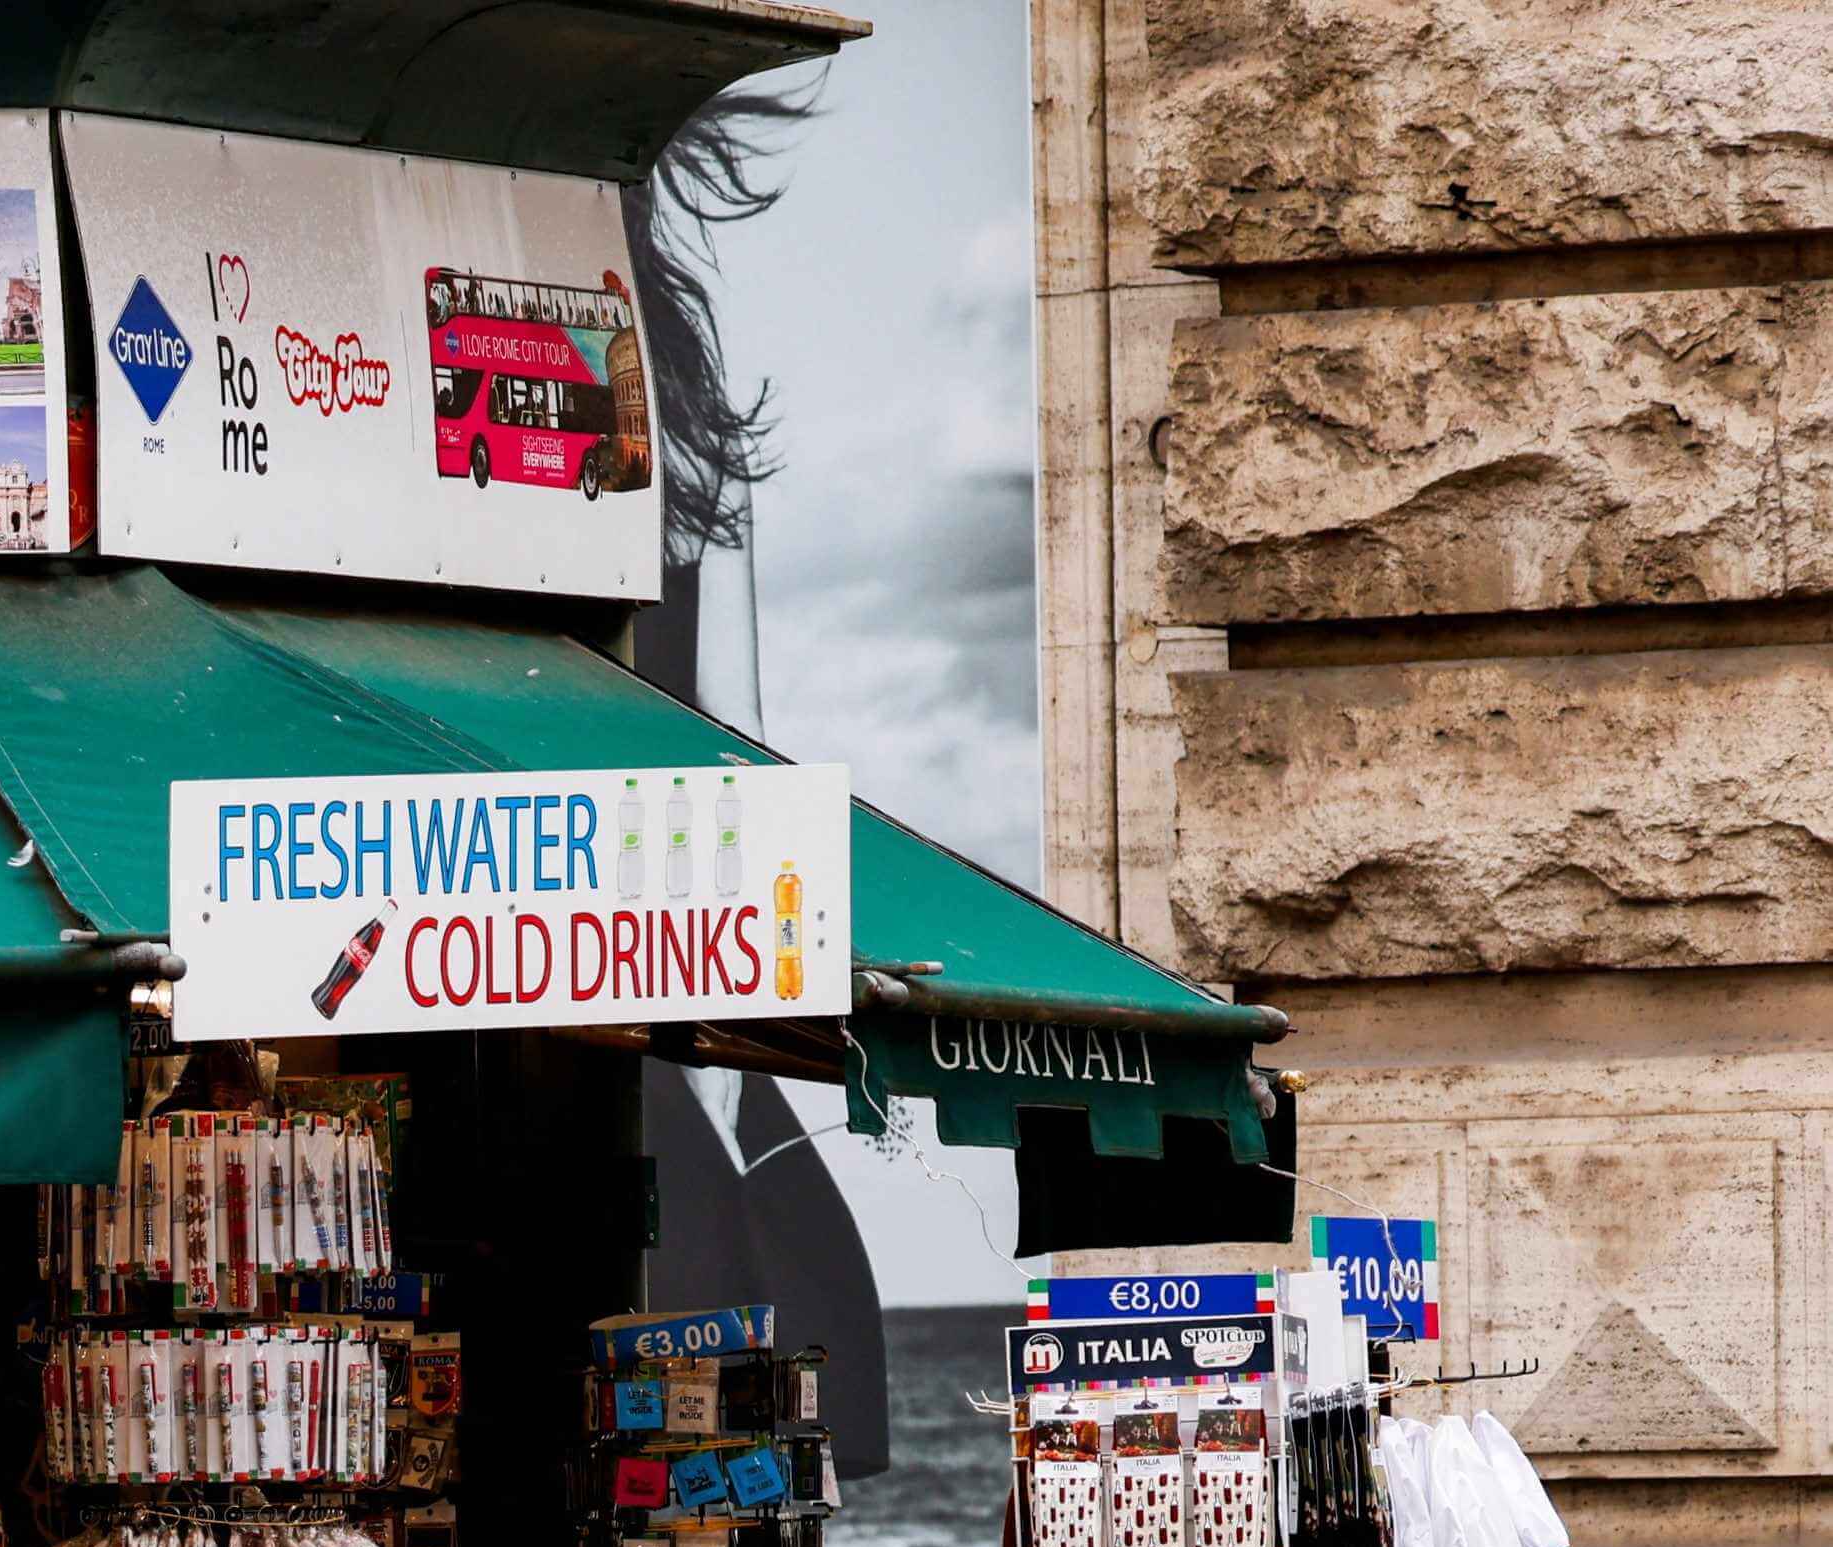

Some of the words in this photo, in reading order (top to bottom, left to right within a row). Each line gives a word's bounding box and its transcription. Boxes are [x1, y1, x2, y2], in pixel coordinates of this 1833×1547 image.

[468, 334, 491, 356] LOVE
[493, 337, 521, 360] ROME
[523, 341, 541, 363] CITY
[543, 344, 571, 367] TOUR
[218, 336, 259, 409] Ro
[143, 437, 165, 455] ROME
[221, 418, 269, 476] me
[522, 452, 565, 471] EVERYWHERE
[218, 798, 393, 903] FRESH
[408, 792, 598, 894] WATER
[406, 912, 553, 1009] COLD
[571, 905, 761, 1003] DRINKS
[931, 1013, 1157, 1087] GIORNALI
[1109, 1280, 1200, 1311] €8,00
[635, 1321, 722, 1358] €3,00
[1078, 1337, 1172, 1366] ITALIA
[1053, 1463, 1079, 1473] ITALIA
[1135, 1457, 1162, 1467] ITALIA
[1216, 1453, 1242, 1463] ITALIA
